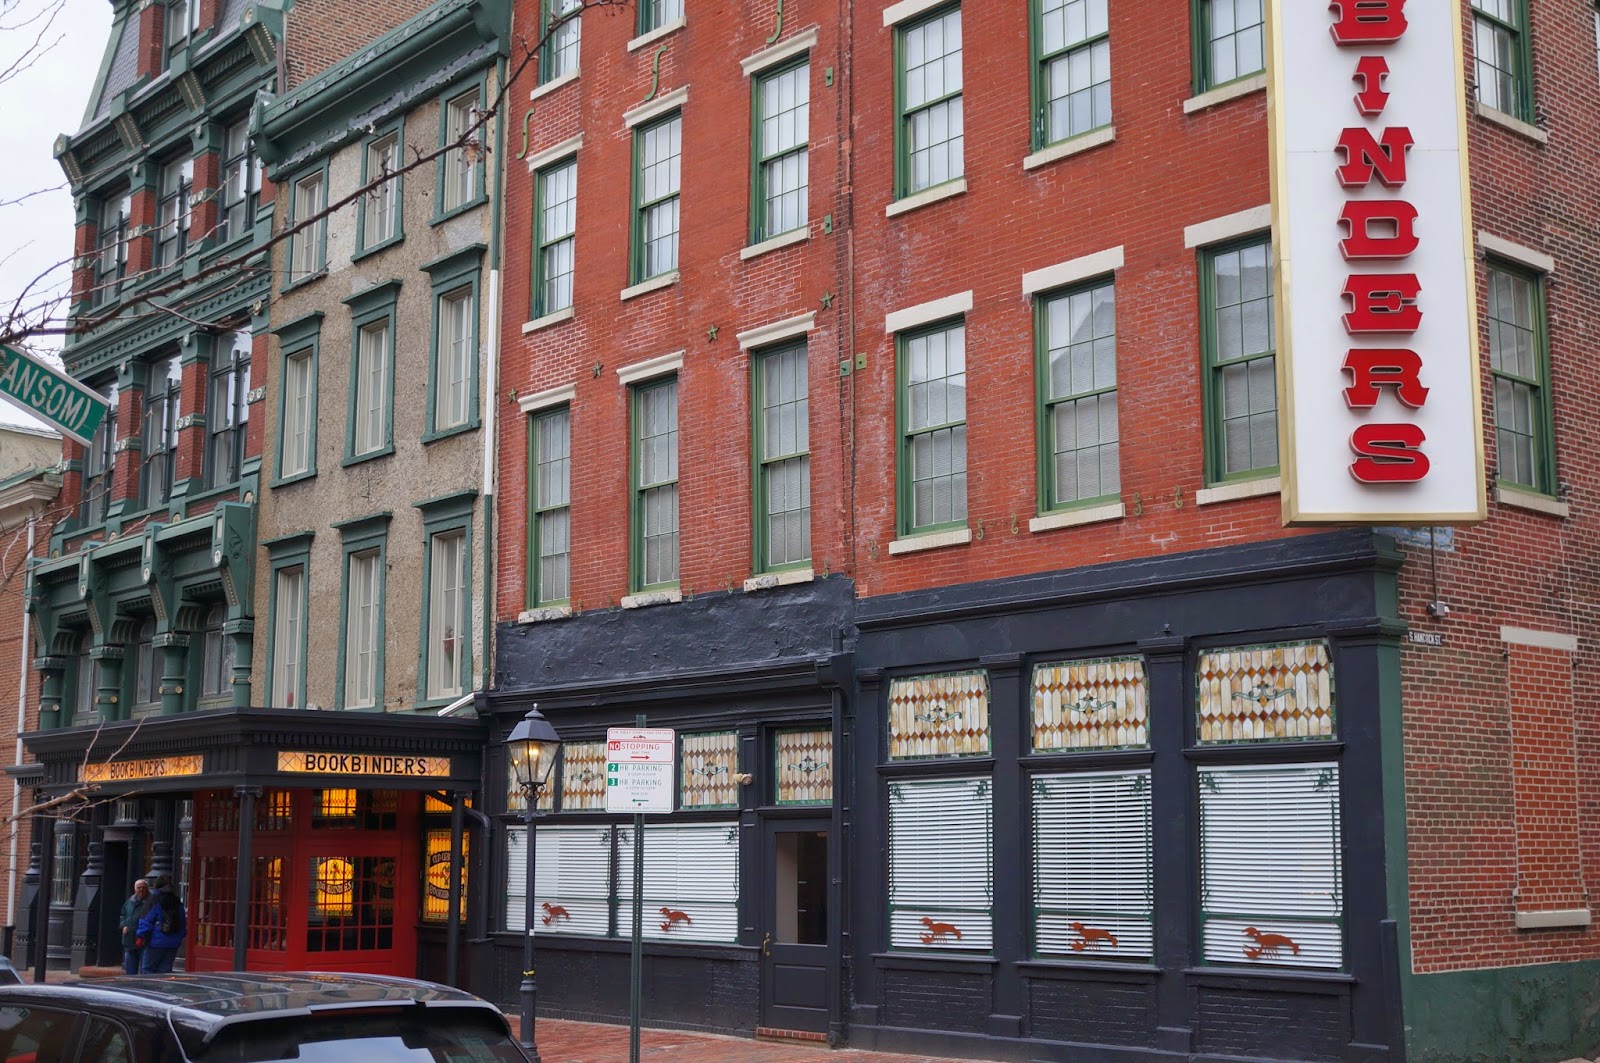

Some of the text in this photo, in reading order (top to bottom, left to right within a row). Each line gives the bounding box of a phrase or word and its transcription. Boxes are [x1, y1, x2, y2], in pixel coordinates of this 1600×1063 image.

[1328, 0, 1430, 483] BINDERS
[611, 764, 616, 772] 2
[632, 764, 662, 772] PARKING
[611, 778, 616, 786] 3
